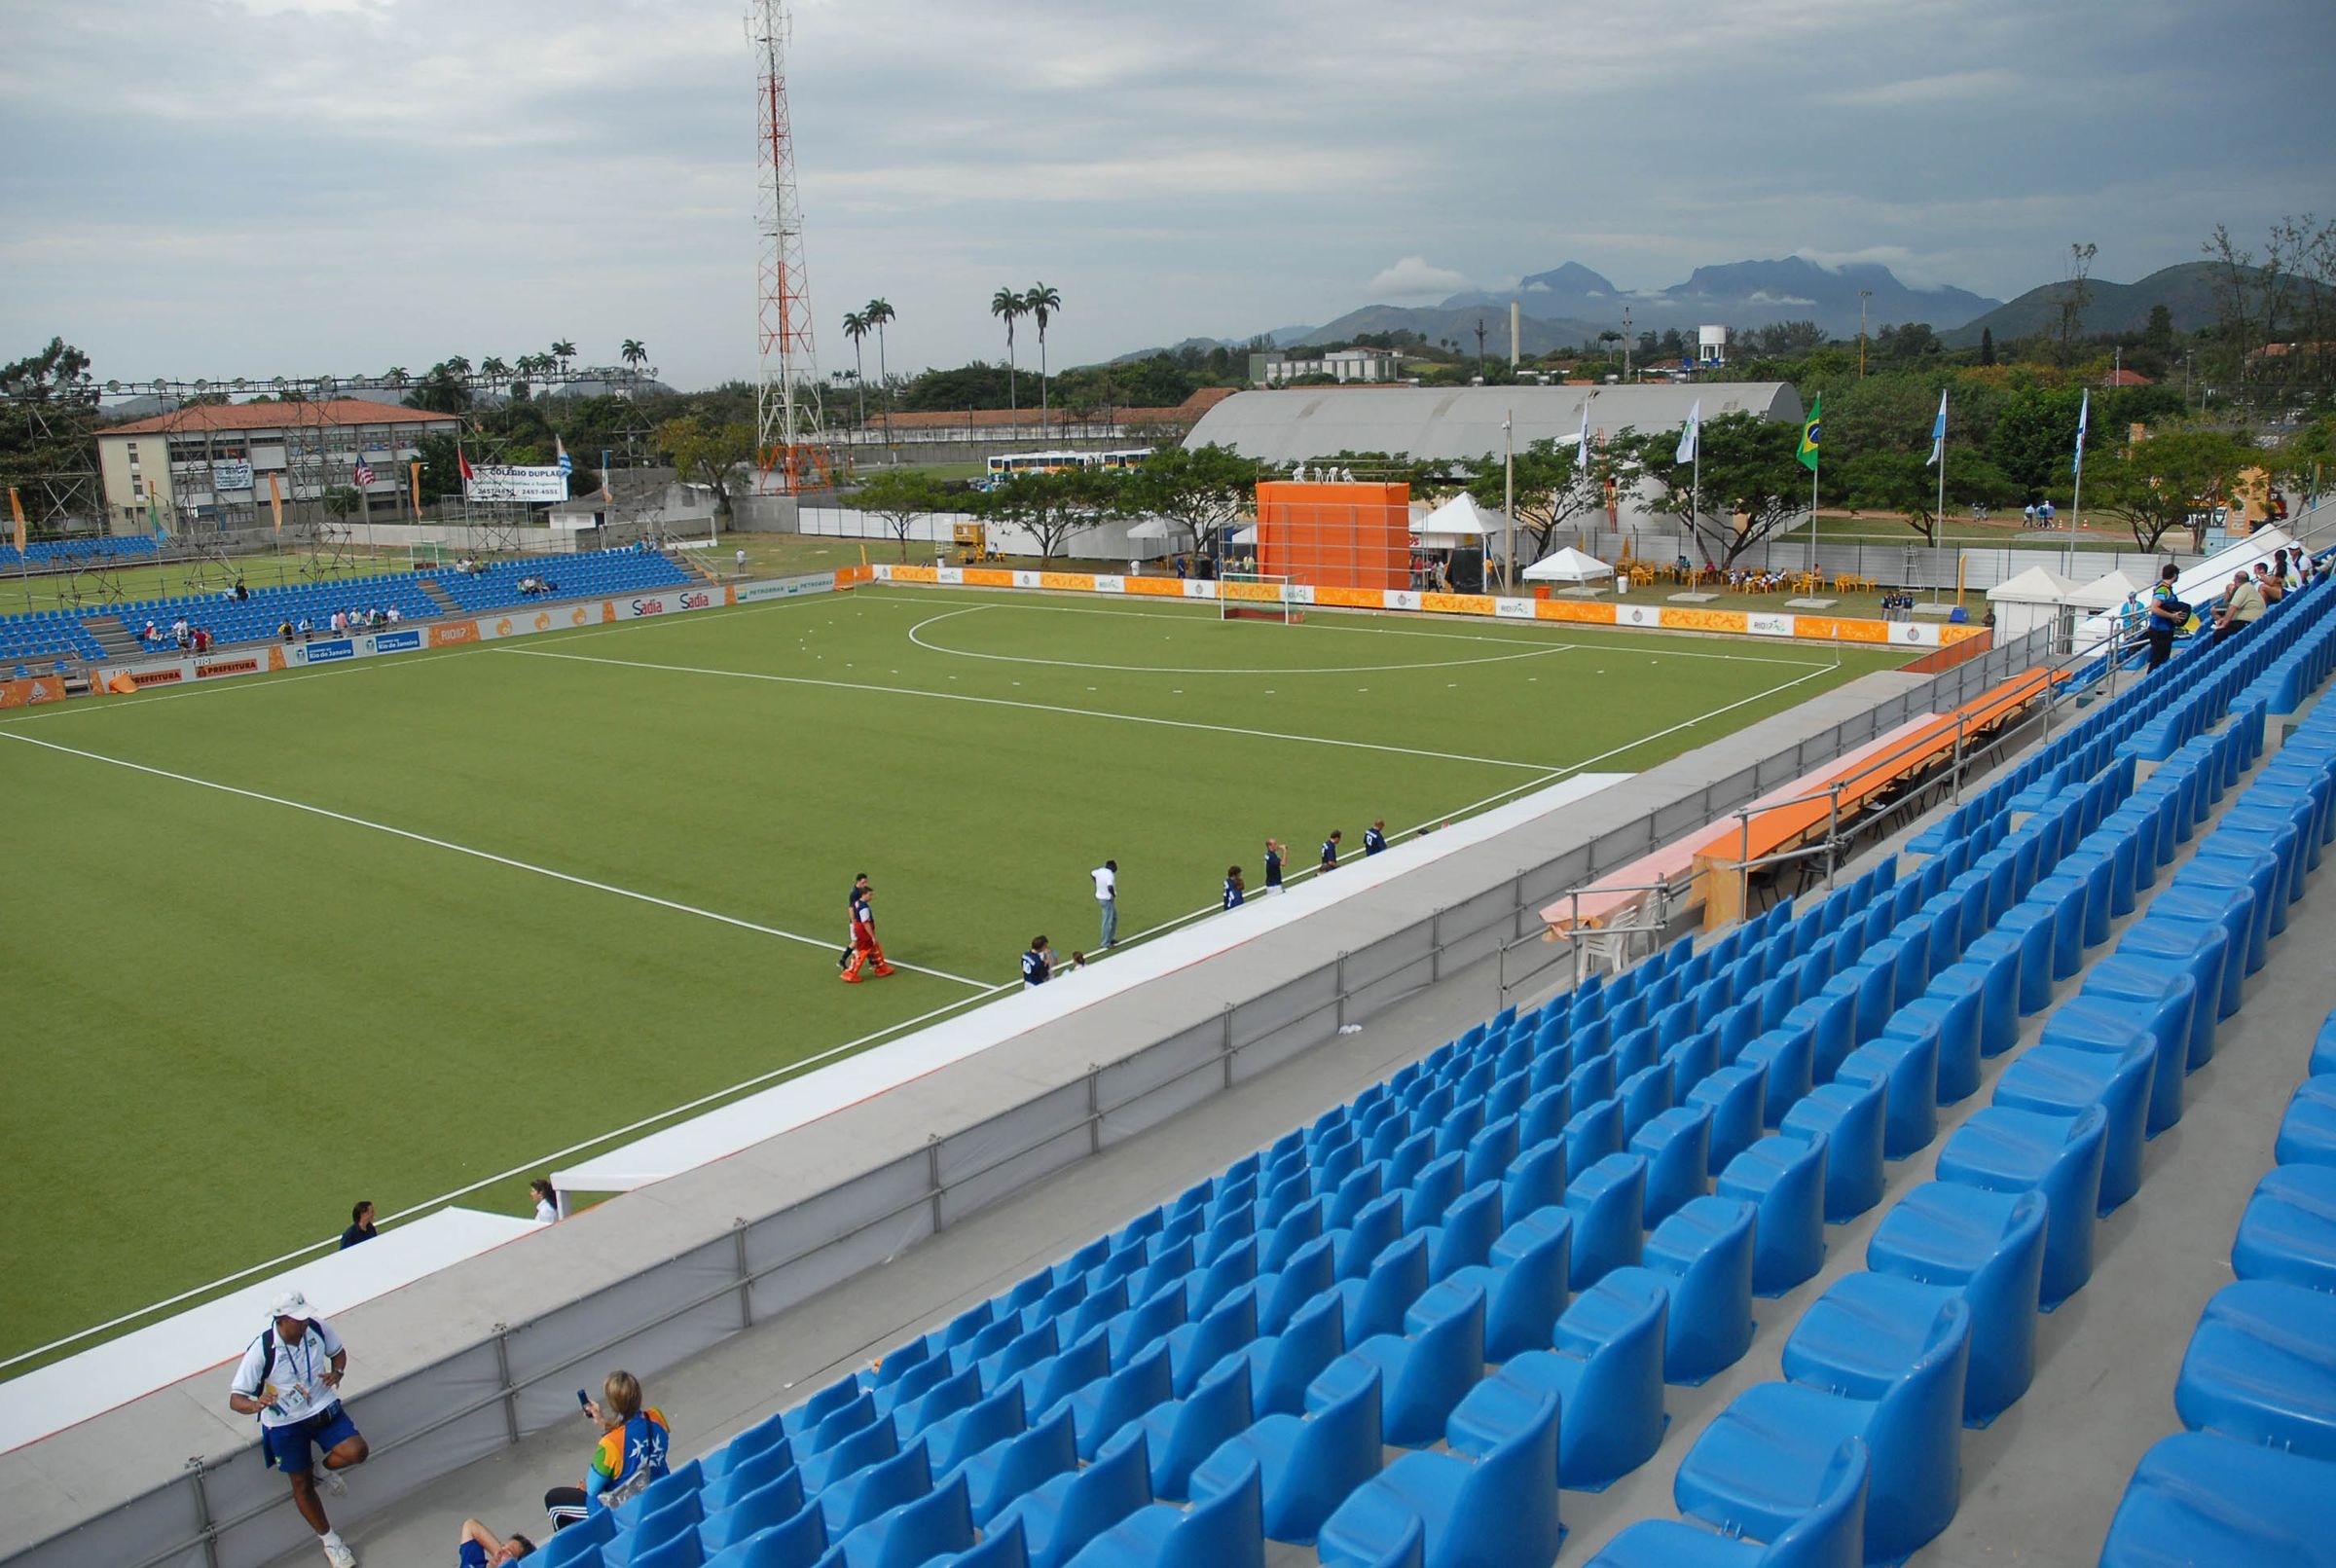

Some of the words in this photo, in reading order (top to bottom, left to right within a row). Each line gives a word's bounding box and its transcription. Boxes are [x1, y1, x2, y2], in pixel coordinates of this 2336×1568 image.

[632, 599, 663, 616] Sadia
[678, 593, 710, 609] Sadia
[208, 661, 256, 674] PREFEITURA
